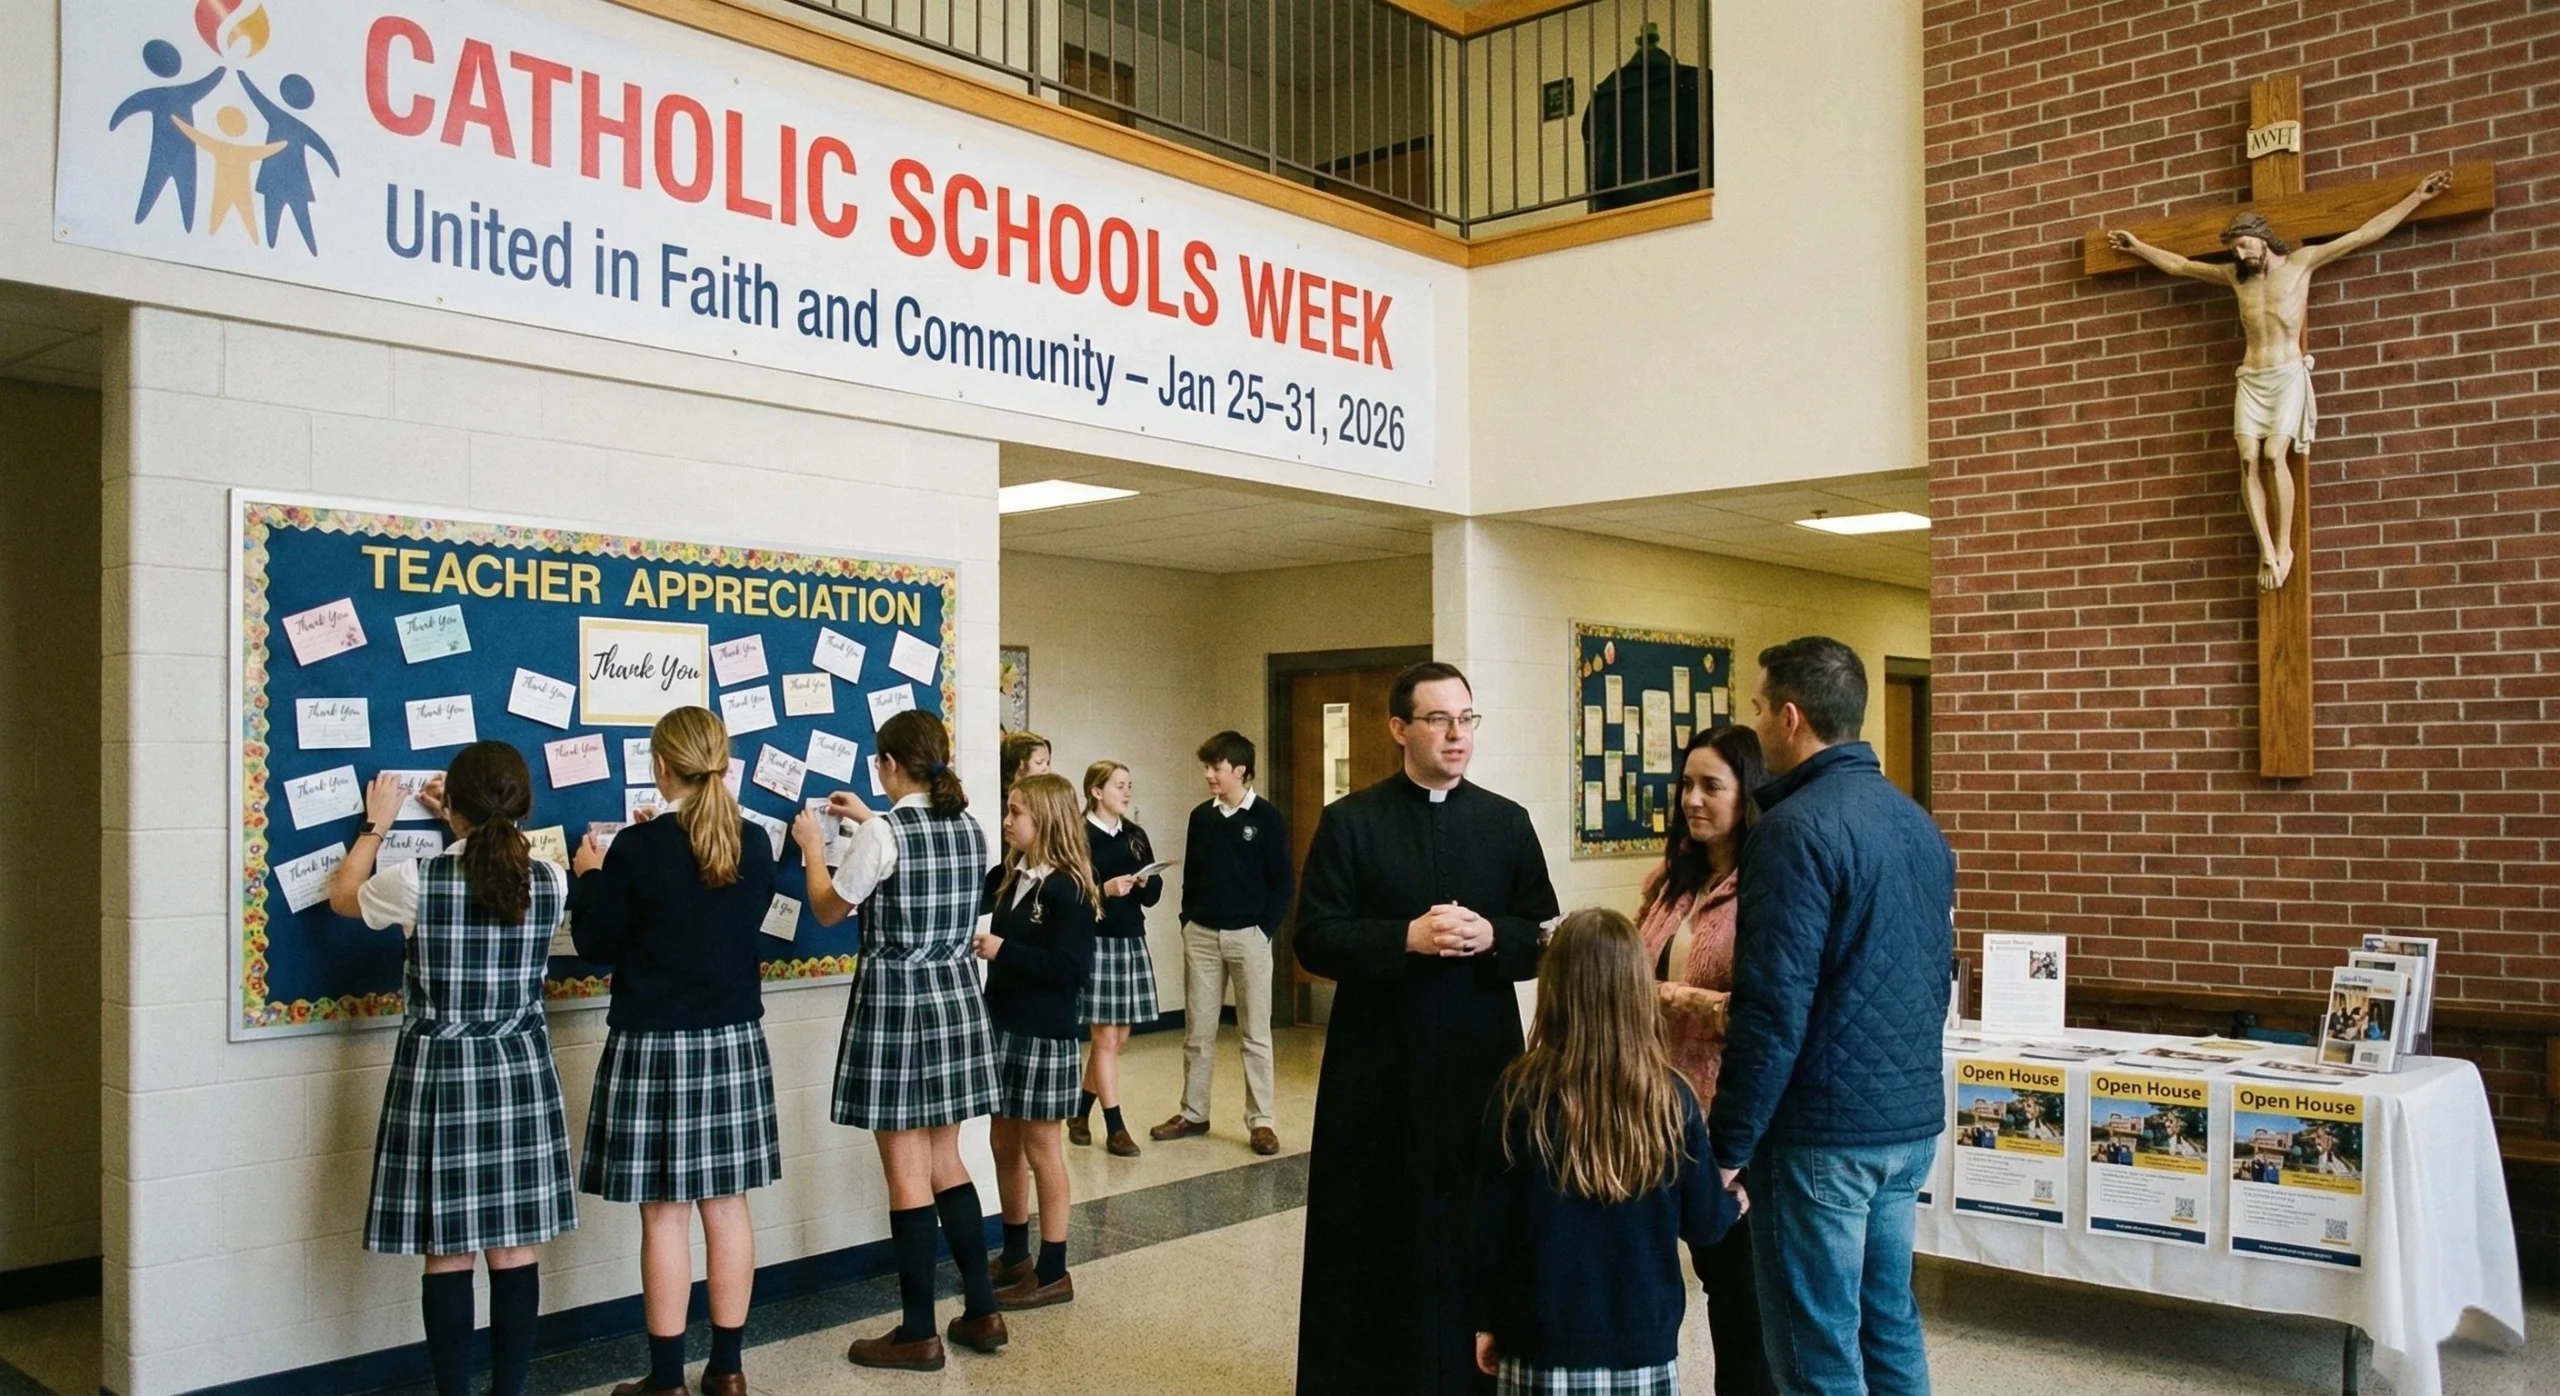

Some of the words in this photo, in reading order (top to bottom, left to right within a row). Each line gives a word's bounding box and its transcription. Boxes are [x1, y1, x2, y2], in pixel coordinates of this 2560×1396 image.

[365, 16, 857, 239] CATHOLIC
[889, 158, 1219, 327] SCHOOLS
[1239, 254, 1394, 370] WEEK
[386, 184, 572, 289] United
[595, 228, 639, 302] in
[661, 244, 779, 329] Faith
[797, 288, 878, 347] and
[895, 295, 1115, 406] Community
[1158, 356, 1216, 415] Jan
[1227, 369, 1329, 447] 25–31,
[1338, 396, 1405, 452] 2026
[361, 545, 601, 604] TEACHER
[625, 568, 921, 627] APPRECIATION
[329, 611, 348, 628] You
[438, 615, 457, 632] You
[588, 643, 655, 681] Thank
[661, 654, 701, 691] You
[308, 701, 337, 720] Thank
[340, 704, 360, 722] You
[416, 703, 443, 720] Thank
[446, 703, 465, 720] You
[581, 742, 599, 758] You
[297, 778, 325, 799] Thank
[329, 777, 348, 793] You
[415, 837, 434, 853] You
[540, 835, 557, 851] You
[289, 859, 317, 882] Thank
[320, 855, 343, 873] You
[1963, 1065, 2005, 1081] Open
[2009, 1068, 2059, 1087] House
[2096, 1077, 2142, 1096] Open
[2147, 1081, 2202, 1100] House
[2240, 1090, 2290, 1110] Open
[2295, 1095, 2356, 1116] House
